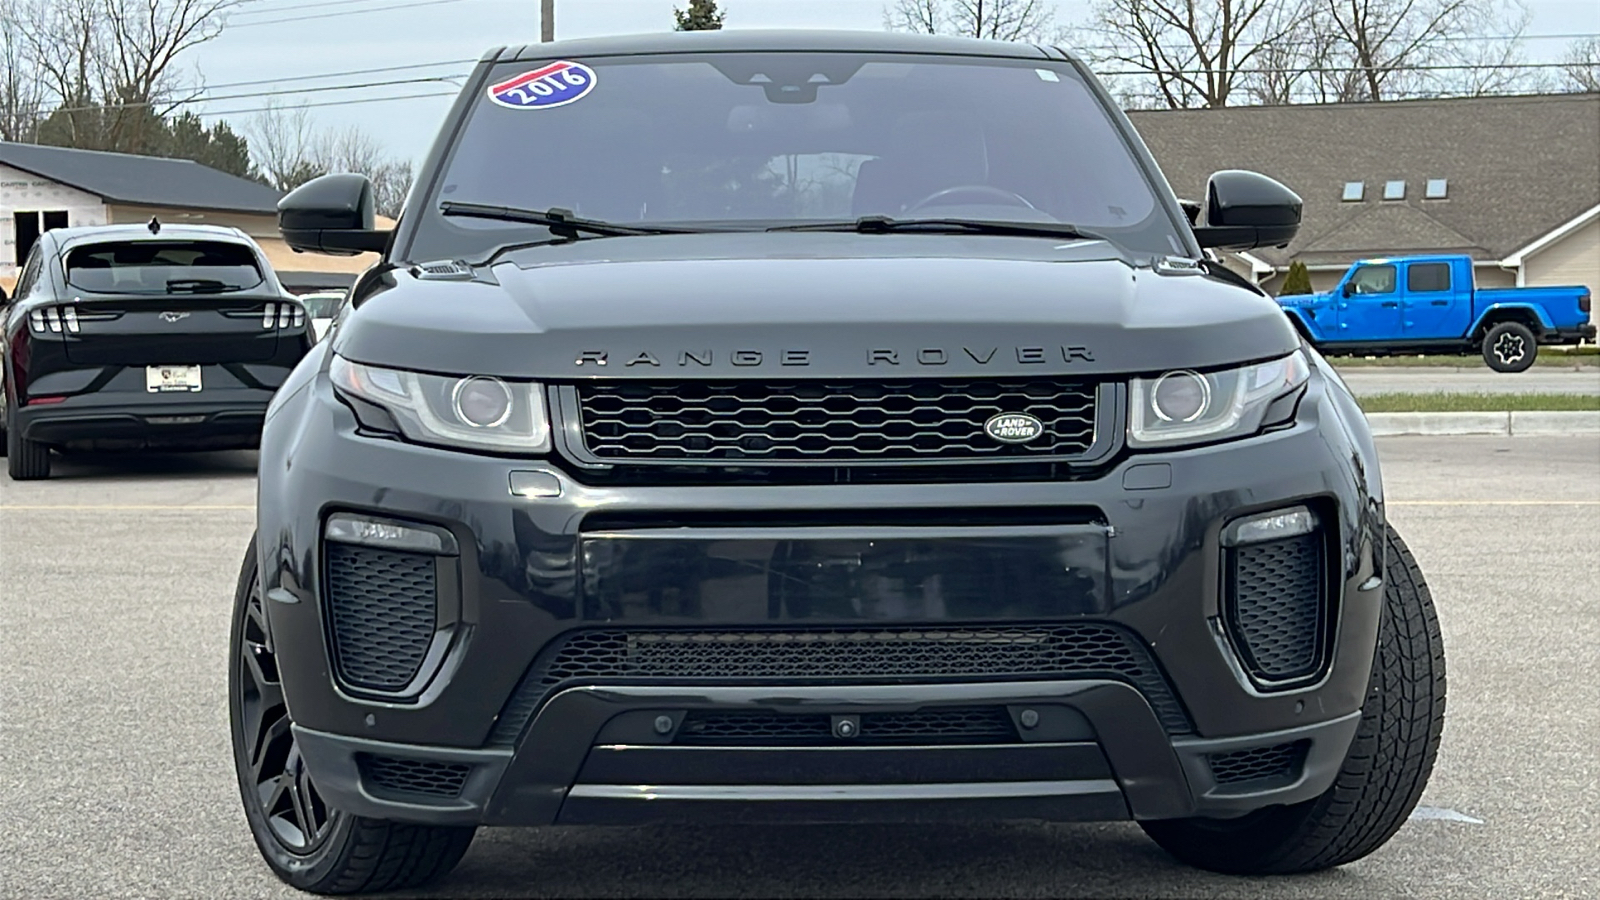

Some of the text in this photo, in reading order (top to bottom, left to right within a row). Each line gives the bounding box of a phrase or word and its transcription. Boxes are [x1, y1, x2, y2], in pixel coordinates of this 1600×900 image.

[507, 70, 586, 104] 2016
[575, 347, 1096, 366] RANGE ROVER
